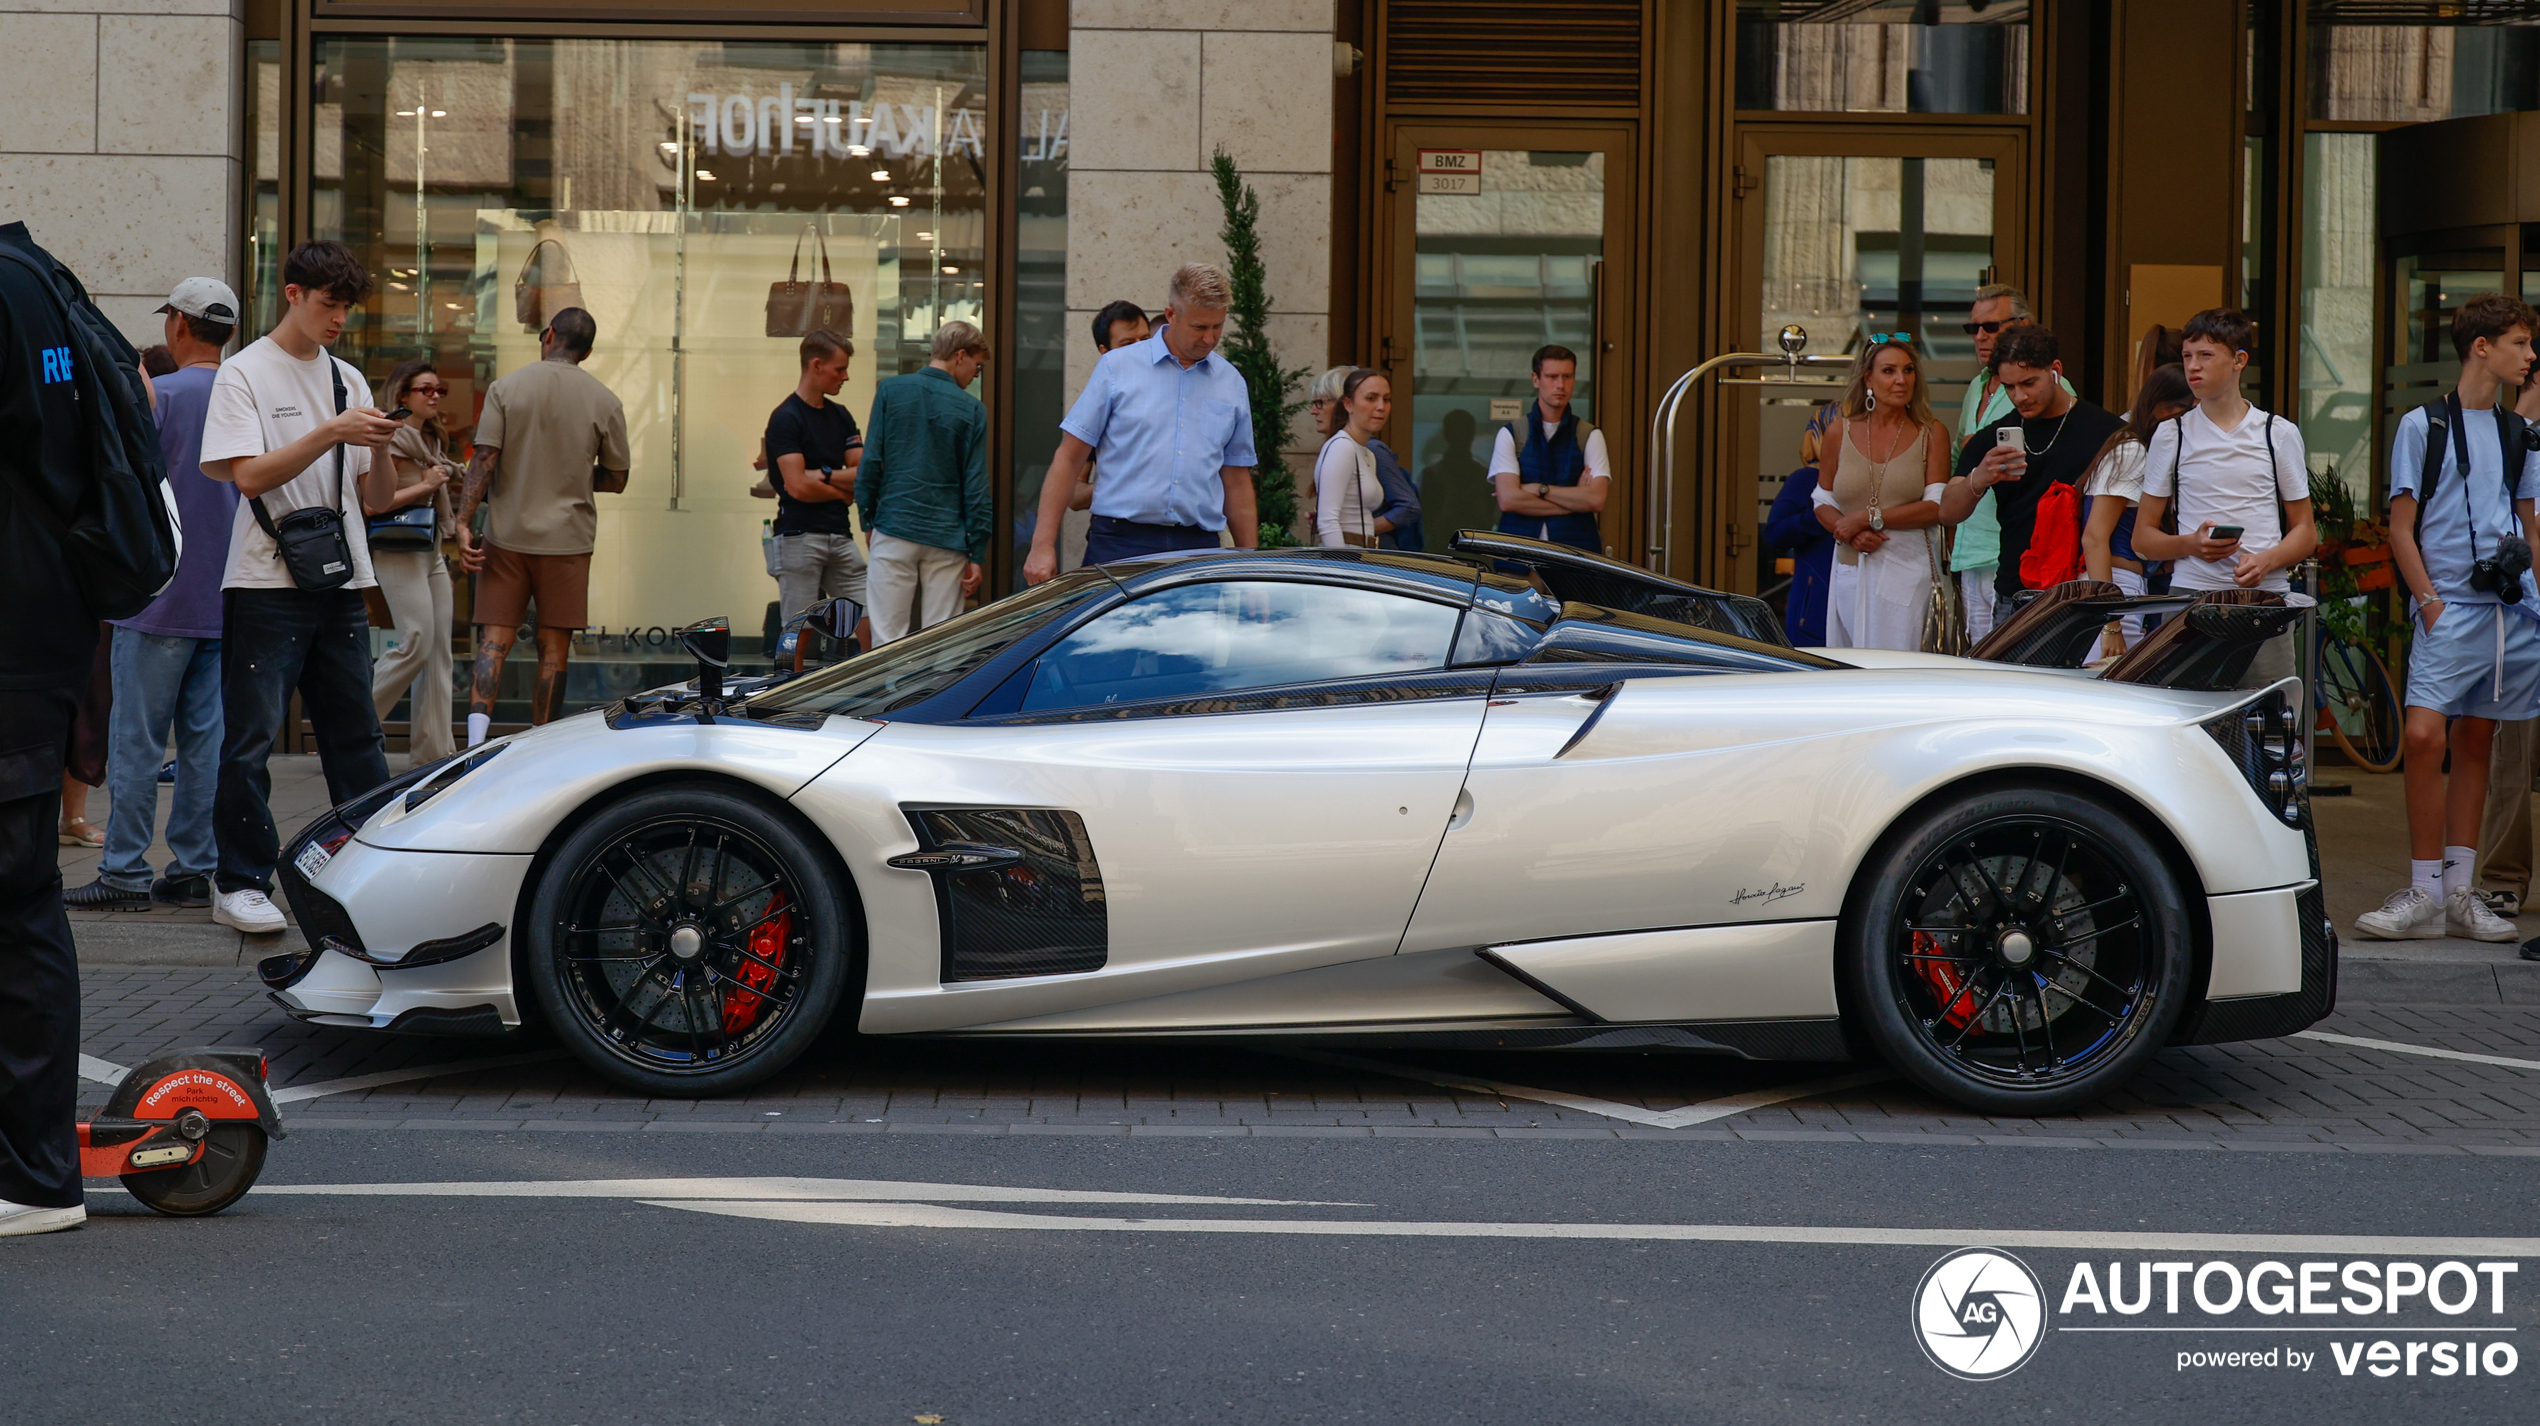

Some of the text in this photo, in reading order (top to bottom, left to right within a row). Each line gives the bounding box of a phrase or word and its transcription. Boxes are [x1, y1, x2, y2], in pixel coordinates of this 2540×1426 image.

[1435, 155, 1465, 168] BMZ
[1432, 177, 1466, 190] 3017
[145, 1074, 190, 1107] Respect
[192, 1073, 214, 1085] the
[215, 1080, 247, 1107] street
[186, 1087, 204, 1095] Park
[171, 1095, 218, 1104] mich richtig
